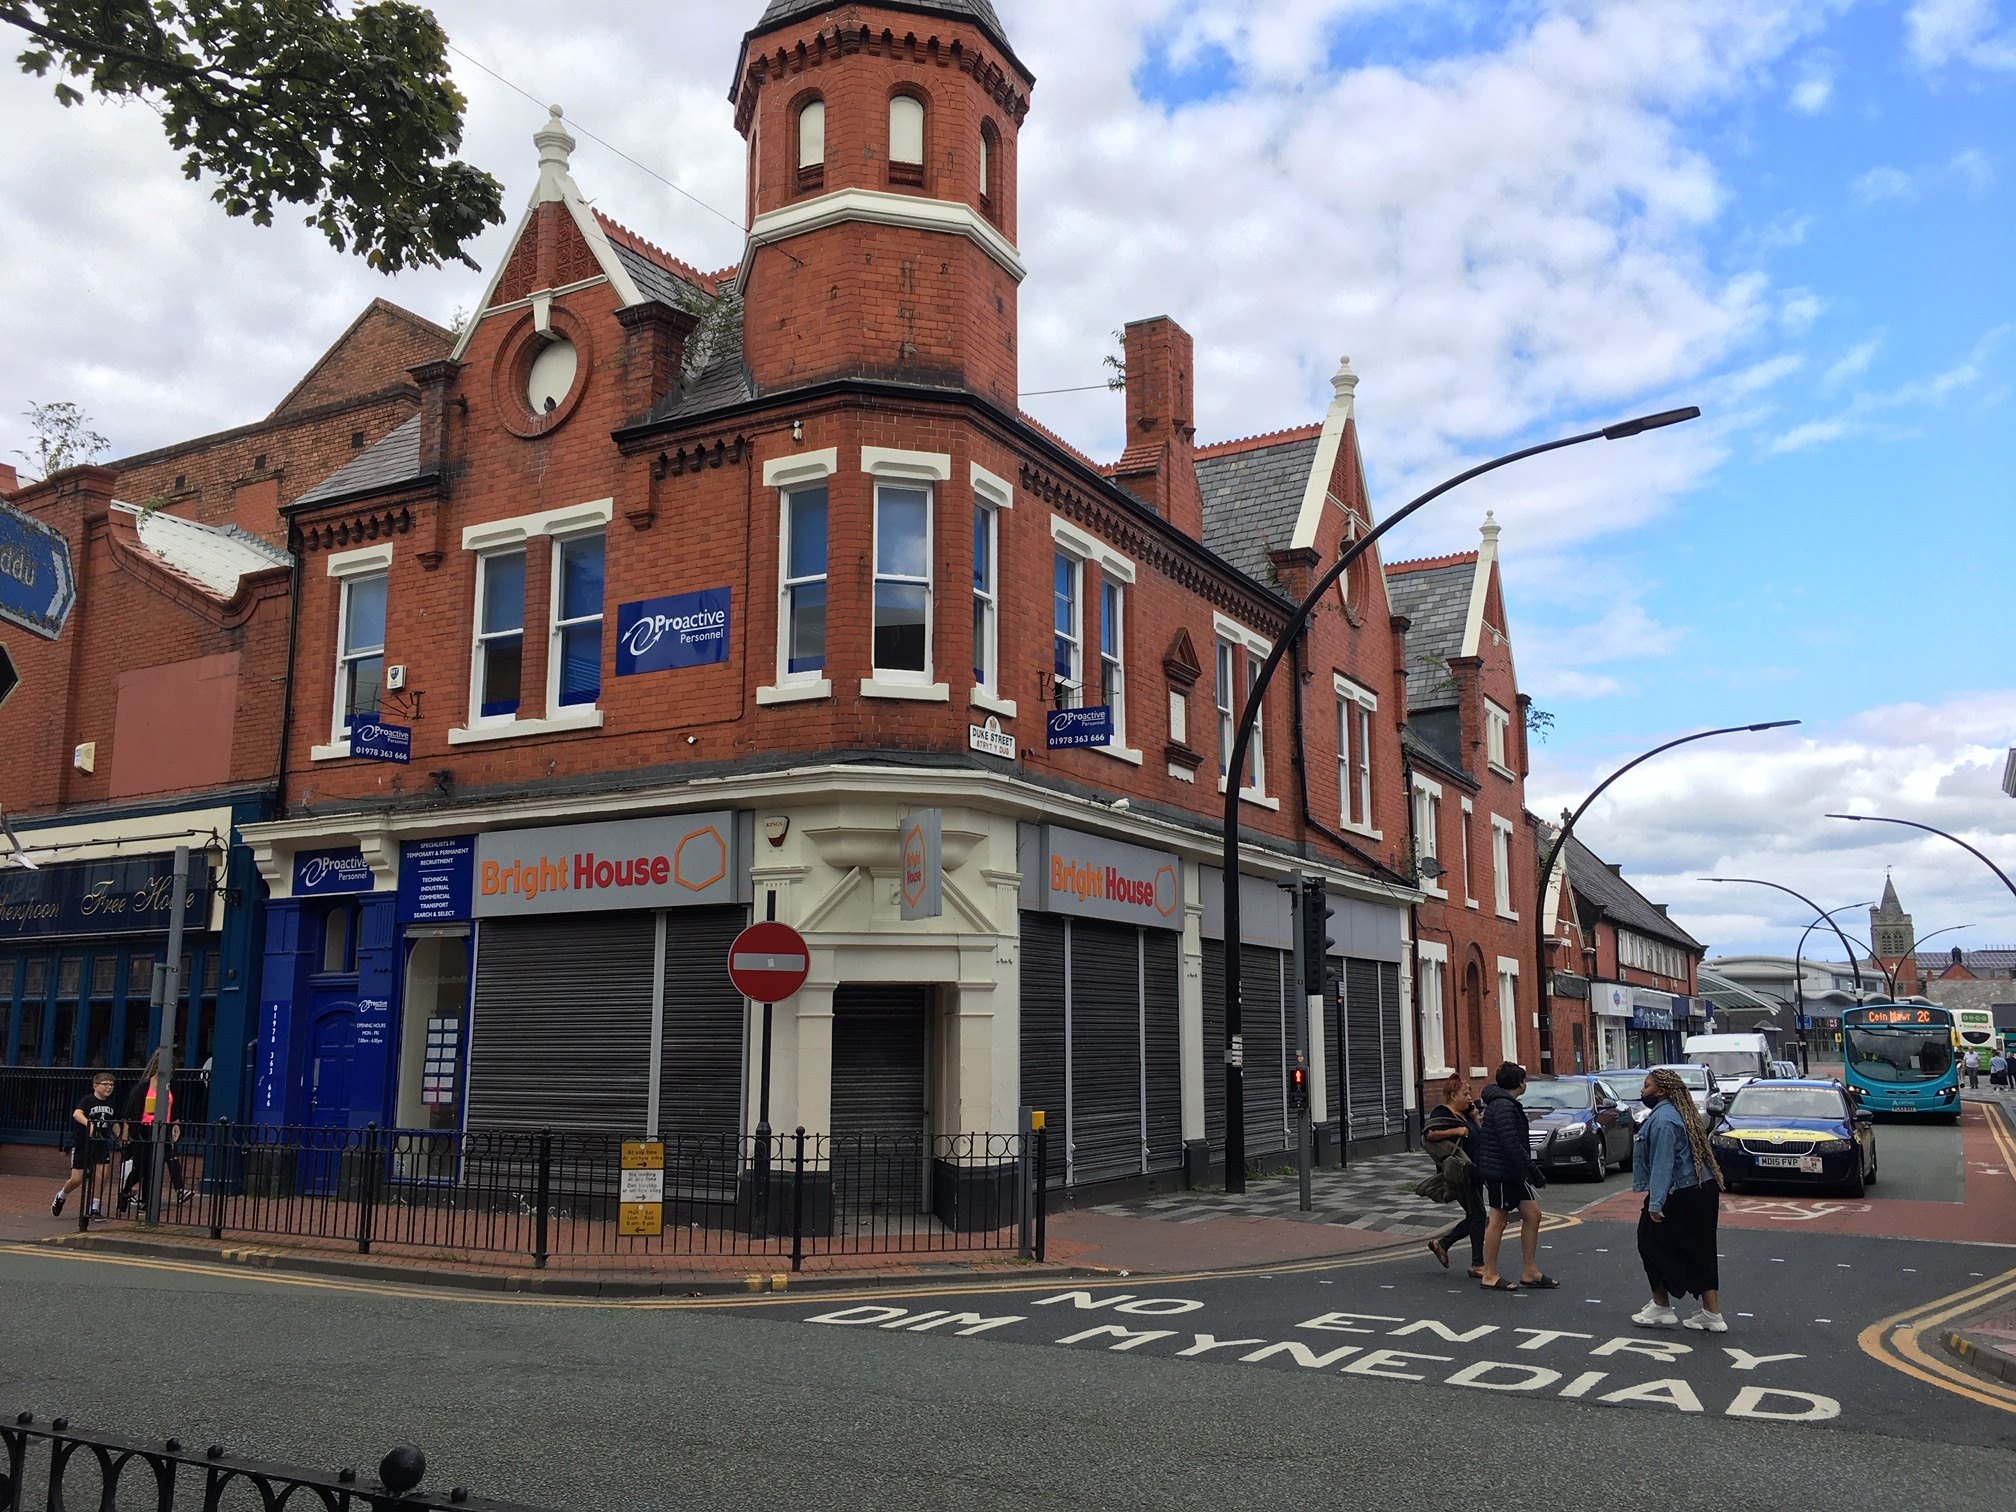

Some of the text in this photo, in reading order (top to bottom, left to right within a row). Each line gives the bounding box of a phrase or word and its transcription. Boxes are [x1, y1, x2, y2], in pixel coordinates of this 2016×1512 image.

[655, 608, 725, 633] Proactive
[680, 628, 724, 644] Personnel
[1068, 710, 1106, 720] Proactive
[374, 725, 409, 738] Proactive
[972, 727, 1013, 747] DUKE STREET
[1049, 733, 1105, 746] 01978 363 666
[355, 746, 408, 760] 01978 363 666
[993, 744, 999, 753] Y
[420, 841, 449, 849] SPECIALISTS
[406, 850, 435, 859] TEMPORARY
[439, 847, 469, 856] PERMANENT
[907, 850, 921, 868] Bright
[322, 855, 368, 870] Proactive
[420, 857, 453, 866] RECRUITMENT
[338, 871, 367, 880] Personnel
[481, 852, 670, 900] Bright House
[906, 870, 921, 885] House
[1051, 854, 1154, 907] Bright House
[420, 884, 449, 892] INDUSTRIAL
[81, 879, 127, 916] Free
[132, 875, 195, 913] Hoe
[418, 893, 450, 901] COMMERCIAL
[1868, 1010, 1930, 1023] Cefn Mawr 2C
[1761, 1158, 1798, 1166] MD15 FVP
[1030, 1291, 1807, 1370] NO ENTRY
[803, 1305, 1841, 1422] DIM MYNEDIAD
